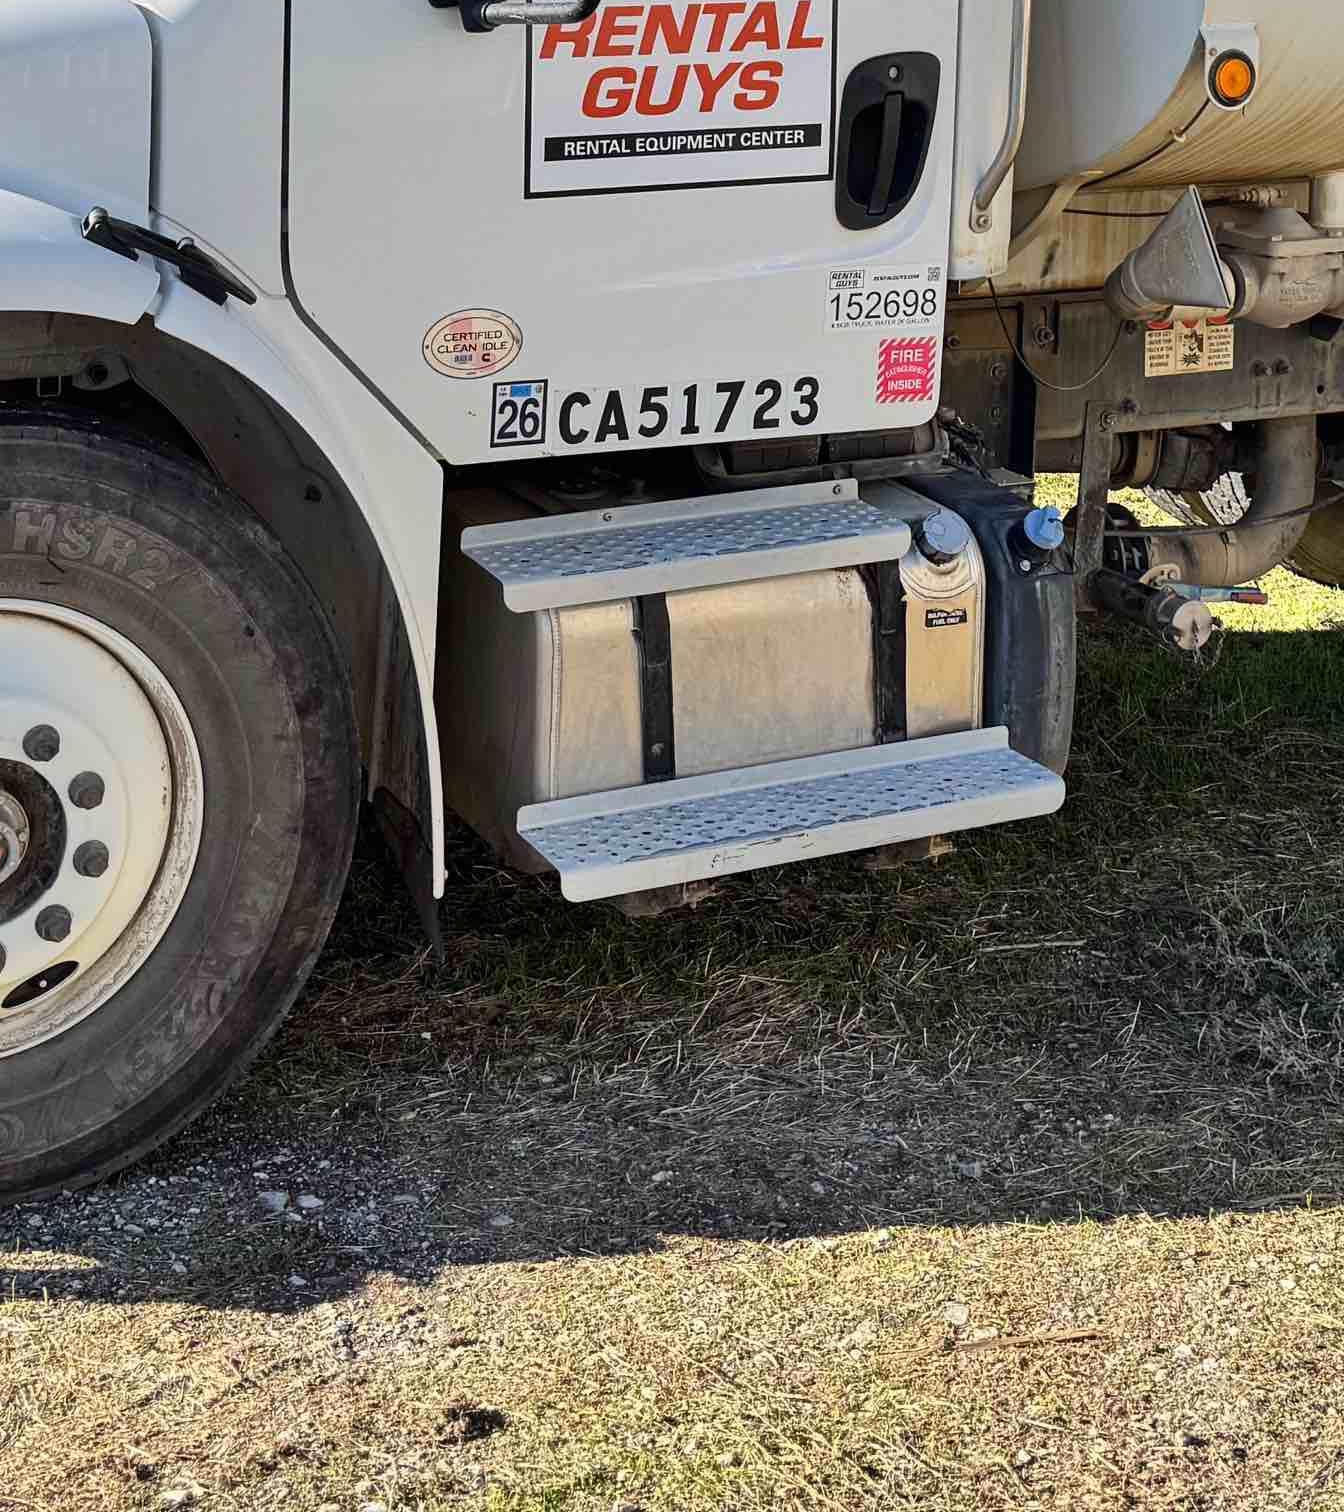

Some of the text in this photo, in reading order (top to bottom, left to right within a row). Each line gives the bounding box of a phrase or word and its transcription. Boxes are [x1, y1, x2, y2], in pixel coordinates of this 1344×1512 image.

[539, 0, 825, 59] RENTAL
[580, 60, 783, 119] GUYS
[564, 129, 805, 157] RENTAL EQUIPMENT CENTER
[832, 271, 862, 280] RENTAL
[836, 279, 859, 287] GUYS
[830, 288, 936, 321] 152698
[444, 330, 502, 342] CERTIFIED
[437, 341, 509, 354] CLEAN IDLE
[890, 348, 924, 364] FIRE
[887, 378, 922, 392] INSIDE
[497, 397, 540, 440] 26
[558, 376, 820, 446] CA51723
